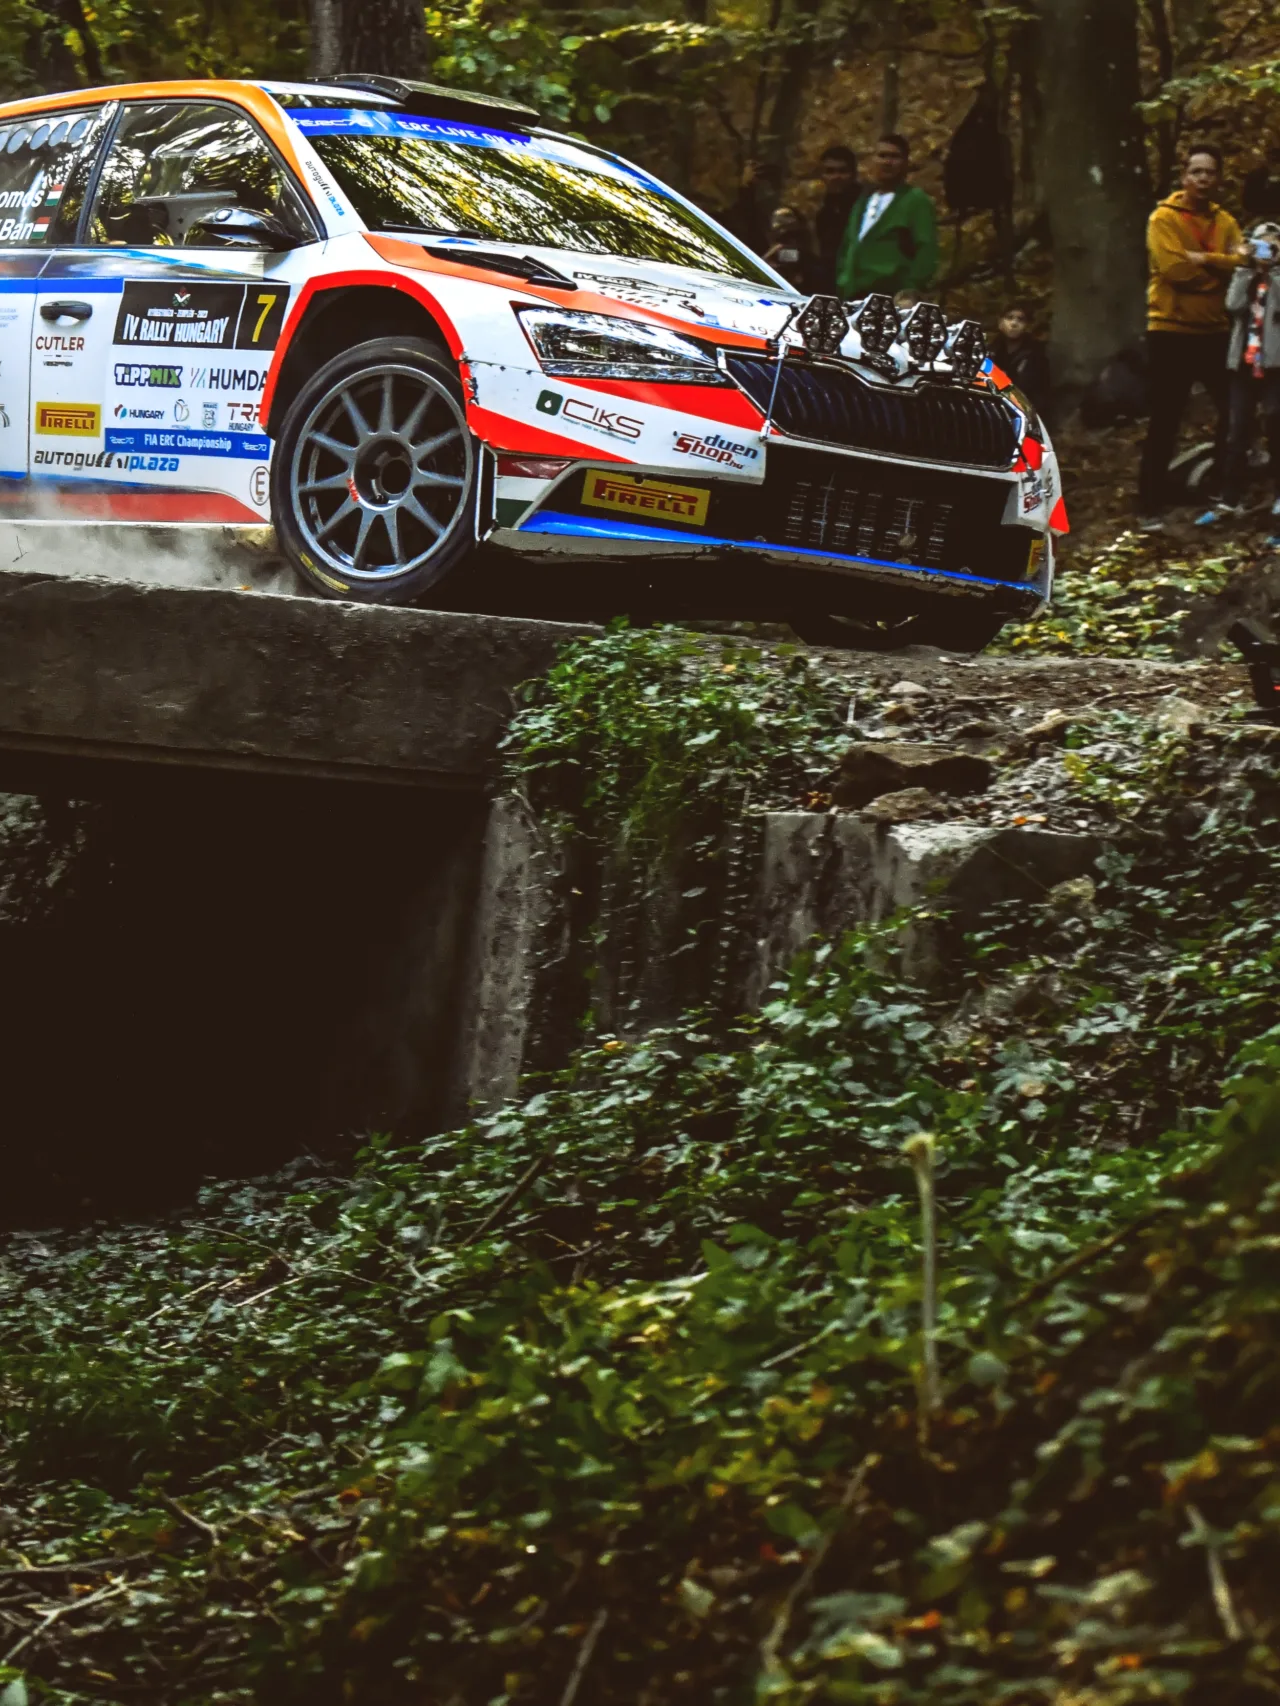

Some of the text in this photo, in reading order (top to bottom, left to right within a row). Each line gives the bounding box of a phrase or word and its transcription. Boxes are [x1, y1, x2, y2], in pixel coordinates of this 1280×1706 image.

[396, 120, 438, 133] ERC
[436, 125, 483, 141] LIVE
[123, 313, 139, 341] IV.
[139, 318, 174, 342] RALLY
[173, 316, 230, 344] HUNGARY
[251, 294, 277, 343] 7
[35, 335, 85, 351] CUTLER
[40, 408, 96, 430] PIRELLI
[129, 409, 166, 420] HUNGARY
[562, 398, 645, 439] CIKS
[228, 421, 255, 432] HUNGARY
[144, 433, 232, 452] FIA ERC Championship
[703, 434, 759, 460] duen
[592, 478, 700, 517] PIRELLI
